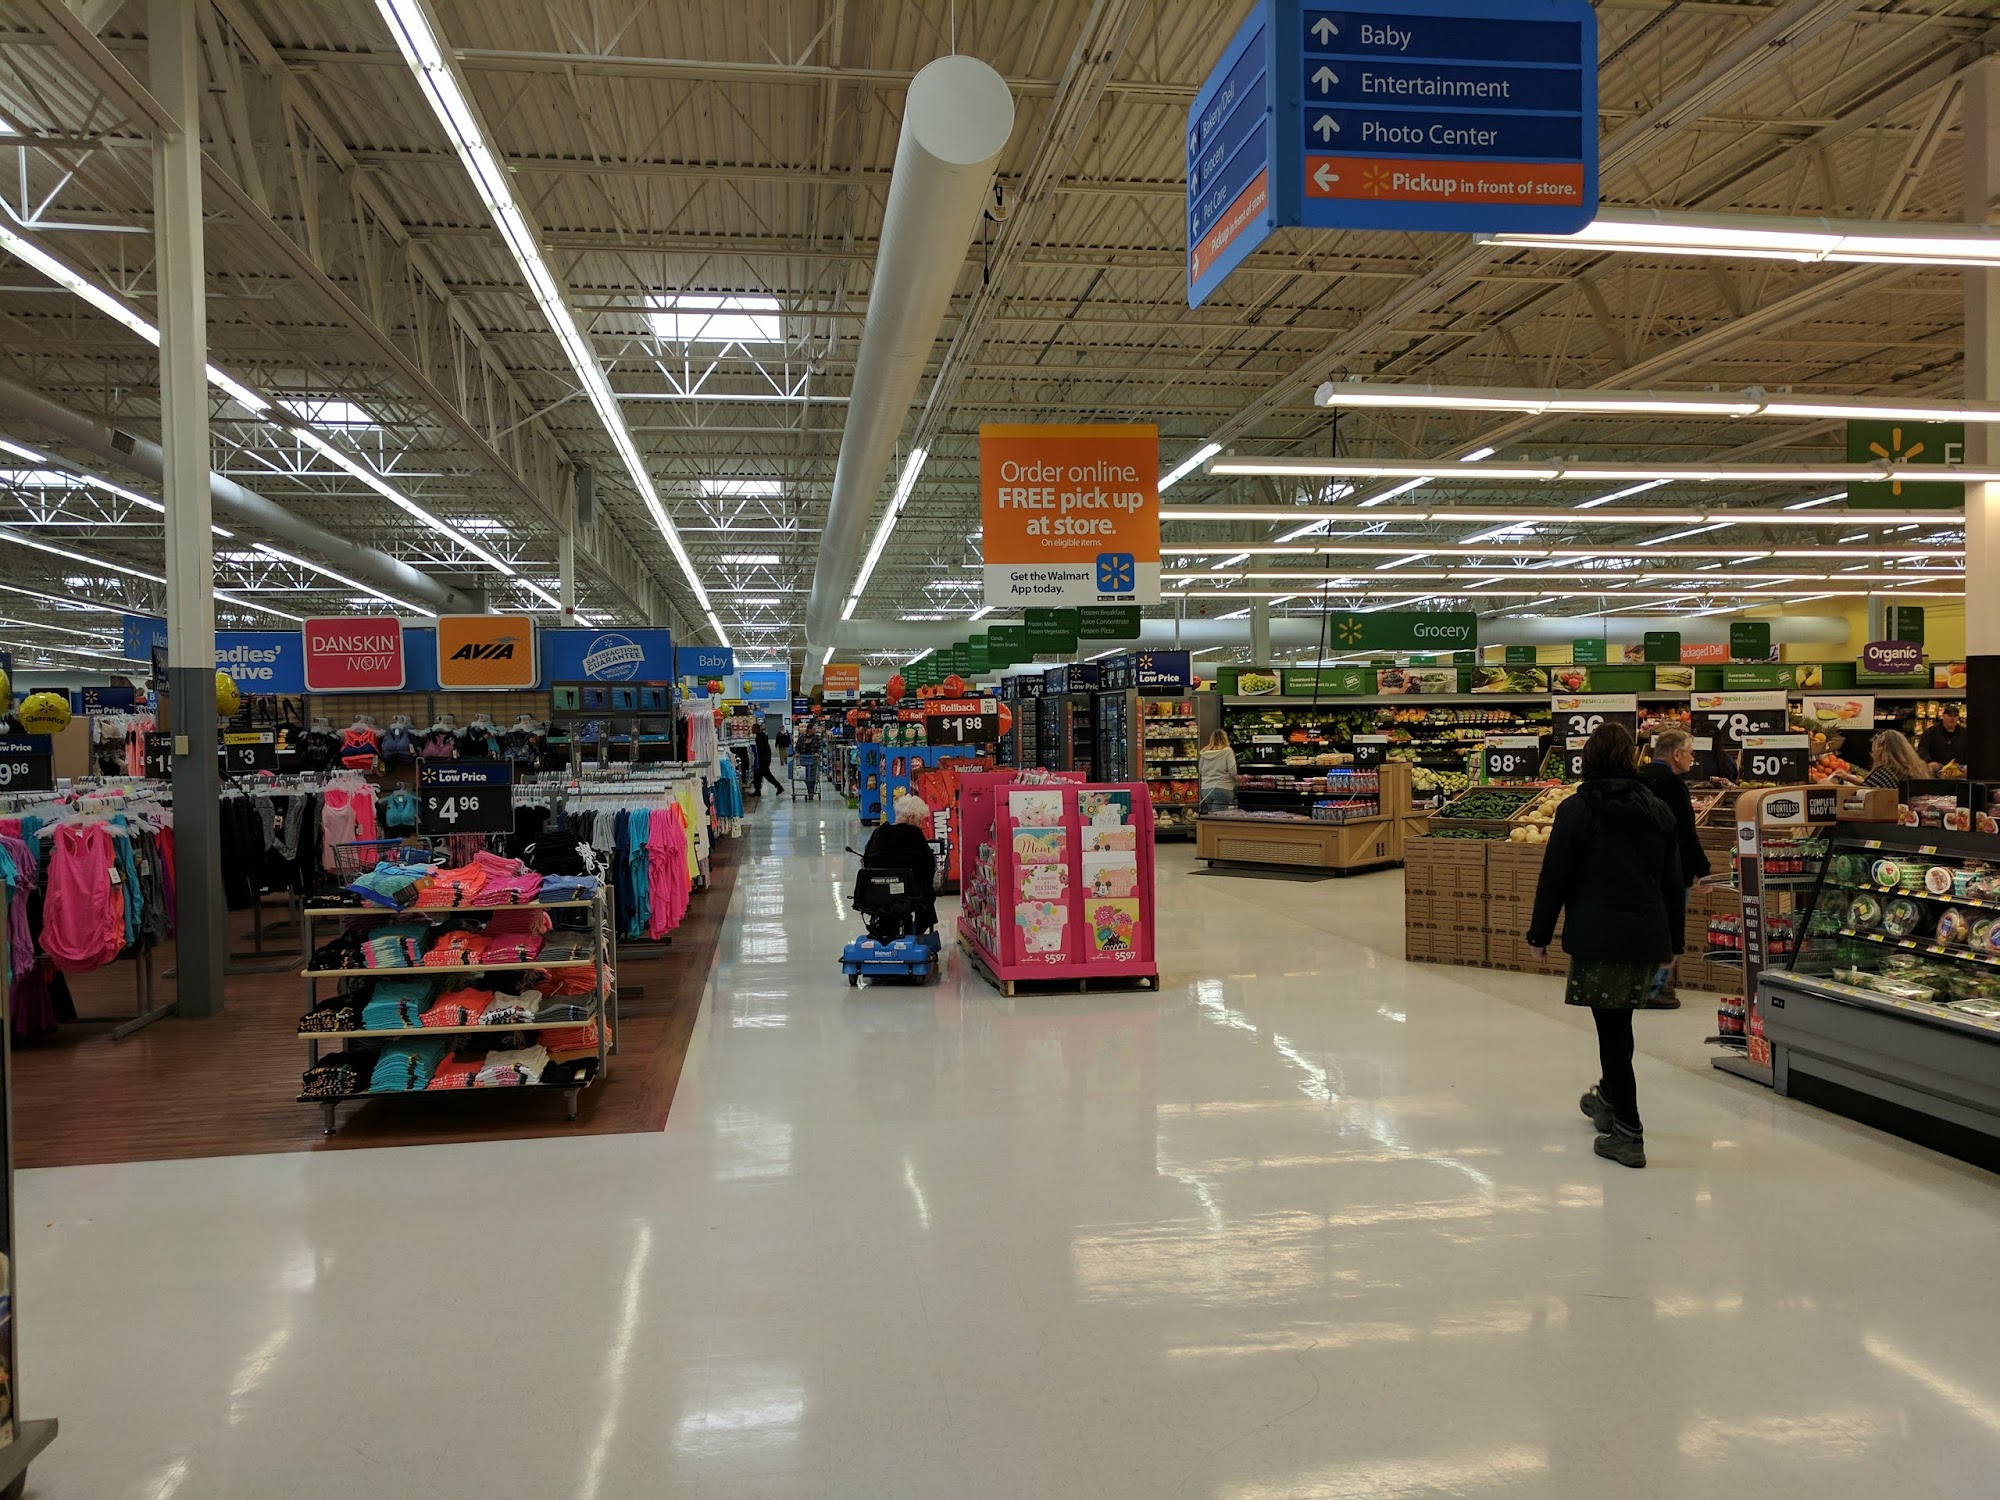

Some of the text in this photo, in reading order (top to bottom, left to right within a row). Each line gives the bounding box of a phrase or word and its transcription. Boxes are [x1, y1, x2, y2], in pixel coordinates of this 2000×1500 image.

[1361, 24, 1411, 51] Baby
[1361, 73, 1510, 98] Entertainment
[1202, 80, 1235, 139] Bakery/Deli
[1361, 121, 1498, 147] Photo Center
[1203, 142, 1225, 180] Grocery
[1392, 173, 1577, 196] Pickup in front of store.
[1203, 185, 1227, 223] Pet Care
[1211, 226, 1229, 255] Pickup
[1234, 209, 1246, 230] front
[1252, 191, 1266, 212] store.
[1001, 460, 1139, 482] Order online.
[998, 487, 1143, 514] FREE pick up
[1027, 516, 1116, 535] at store.
[1041, 538, 1102, 549] On eligible items.
[1010, 571, 1090, 581] Get the Walmart
[1011, 584, 1064, 594] App today.
[1081, 618, 1095, 626] Juice
[1044, 628, 1070, 636] Vegetables
[1413, 622, 1470, 641] Grocery
[312, 635, 394, 652] DANSKIN
[450, 643, 514, 660] AVIA
[1680, 645, 1723, 658] Packaged Deli
[215, 646, 281, 662] adies'
[586, 647, 639, 666] SATISFACTION
[588, 652, 641, 671] GUARANTEE
[699, 655, 728, 669] Baby
[1869, 646, 1917, 662] Organic
[347, 656, 392, 671] NOW
[216, 664, 273, 680] ctive
[1158, 674, 1179, 682] Price
[149, 693, 155, 701] B
[940, 703, 976, 713] Rollback
[26, 715, 65, 725] Clearance
[942, 717, 982, 742] $198
[239, 750, 255, 765] $3
[1490, 755, 1521, 772] 98¢
[1571, 756, 1582, 774] 8
[1752, 755, 1788, 775] 50¢
[0, 763, 29, 785] 996
[439, 772, 487, 782] Low Price
[429, 797, 479, 823] $496
[1767, 803, 1799, 813] EFFORTLESS
[1809, 798, 1835, 807] COMPLETE
[1809, 807, 1828, 815] READY
[1016, 838, 1052, 855] Mom
[1743, 895, 1760, 903] COMPLETE
[1745, 908, 1757, 916] MEALS
[1746, 919, 1758, 928] READY
[1749, 943, 1759, 952] YOUR
[1045, 953, 1066, 964] $597
[1115, 952, 1136, 962] $597
[1749, 954, 1760, 963] TABLE
